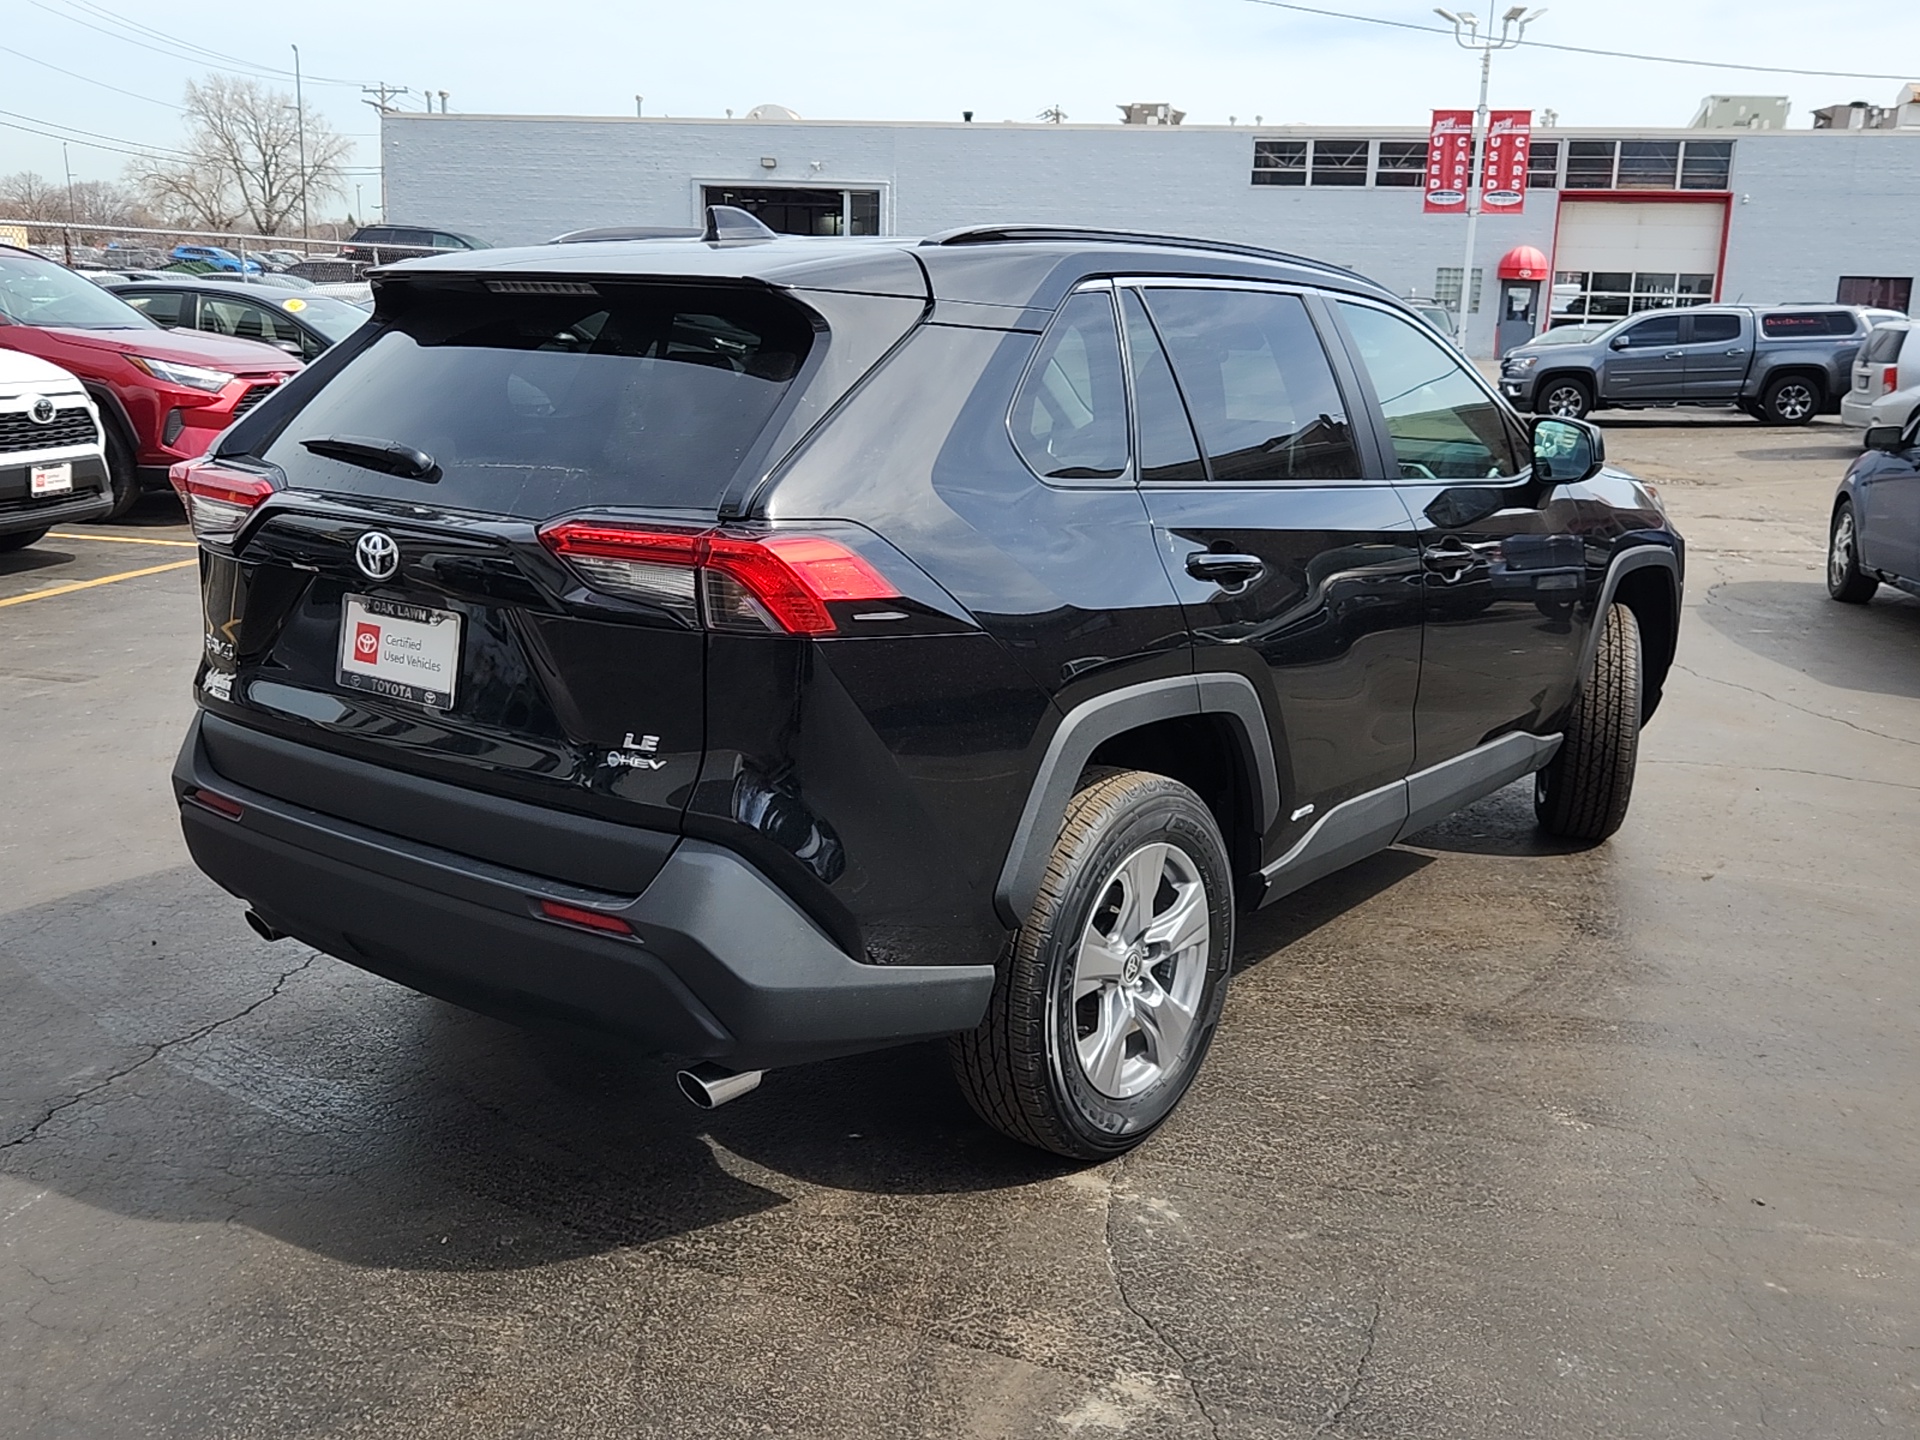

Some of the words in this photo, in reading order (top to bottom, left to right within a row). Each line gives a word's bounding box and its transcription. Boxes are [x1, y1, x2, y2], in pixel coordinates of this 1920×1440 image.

[1430, 137, 1444, 189] USED
[1453, 136, 1467, 189] CARS
[1486, 138, 1501, 190] USED
[1511, 137, 1526, 190] CARS
[373, 601, 395, 616] OAK
[397, 604, 427, 621] LAWN
[385, 634, 422, 651] Certified
[384, 650, 404, 664] Used
[405, 654, 441, 672] Vehicles
[371, 678, 413, 699] TOYOTA
[622, 732, 660, 752] LE
